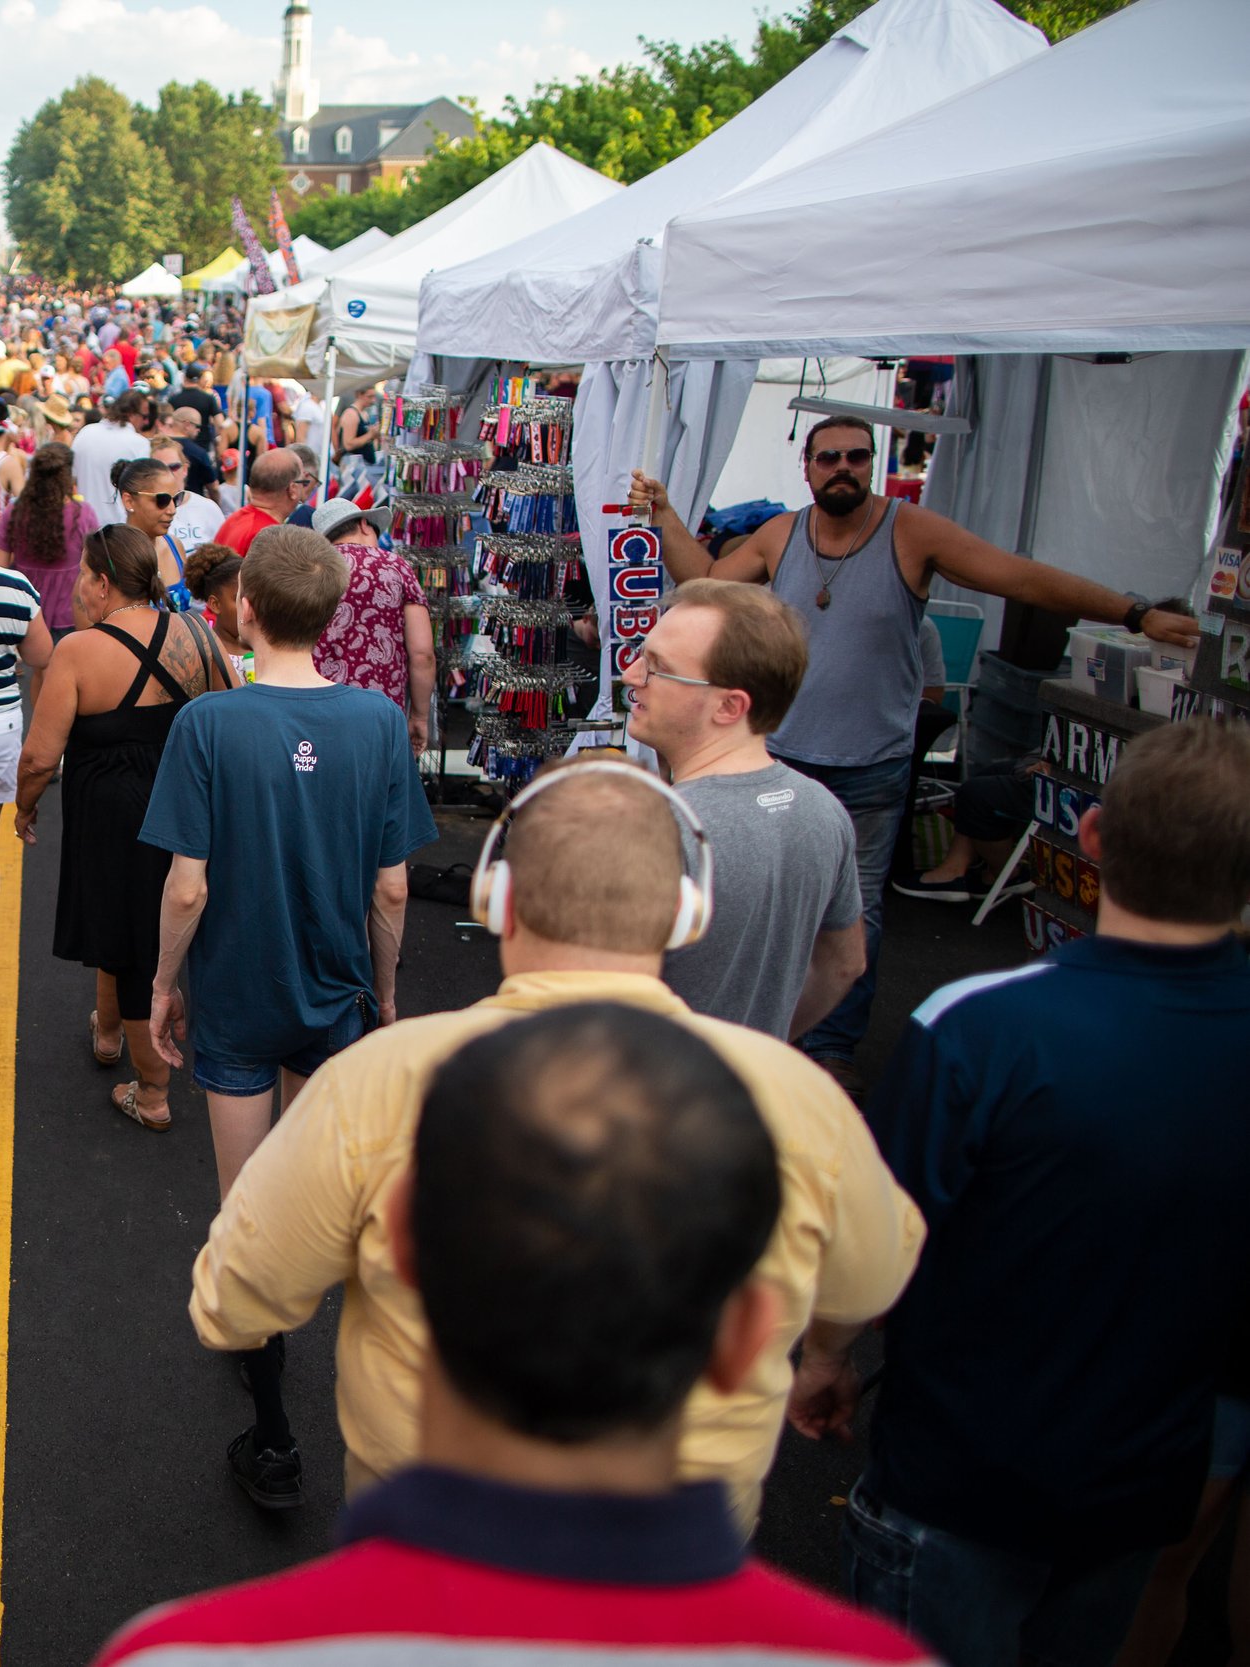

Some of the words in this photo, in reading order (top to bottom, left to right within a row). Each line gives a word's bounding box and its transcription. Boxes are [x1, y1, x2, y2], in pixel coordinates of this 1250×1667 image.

[1218, 551, 1240, 569] VISA
[1041, 714, 1127, 785] ARM
[293, 753, 317, 764] Puppy
[295, 763, 314, 772] Pride
[759, 791, 792, 804] Nintendo
